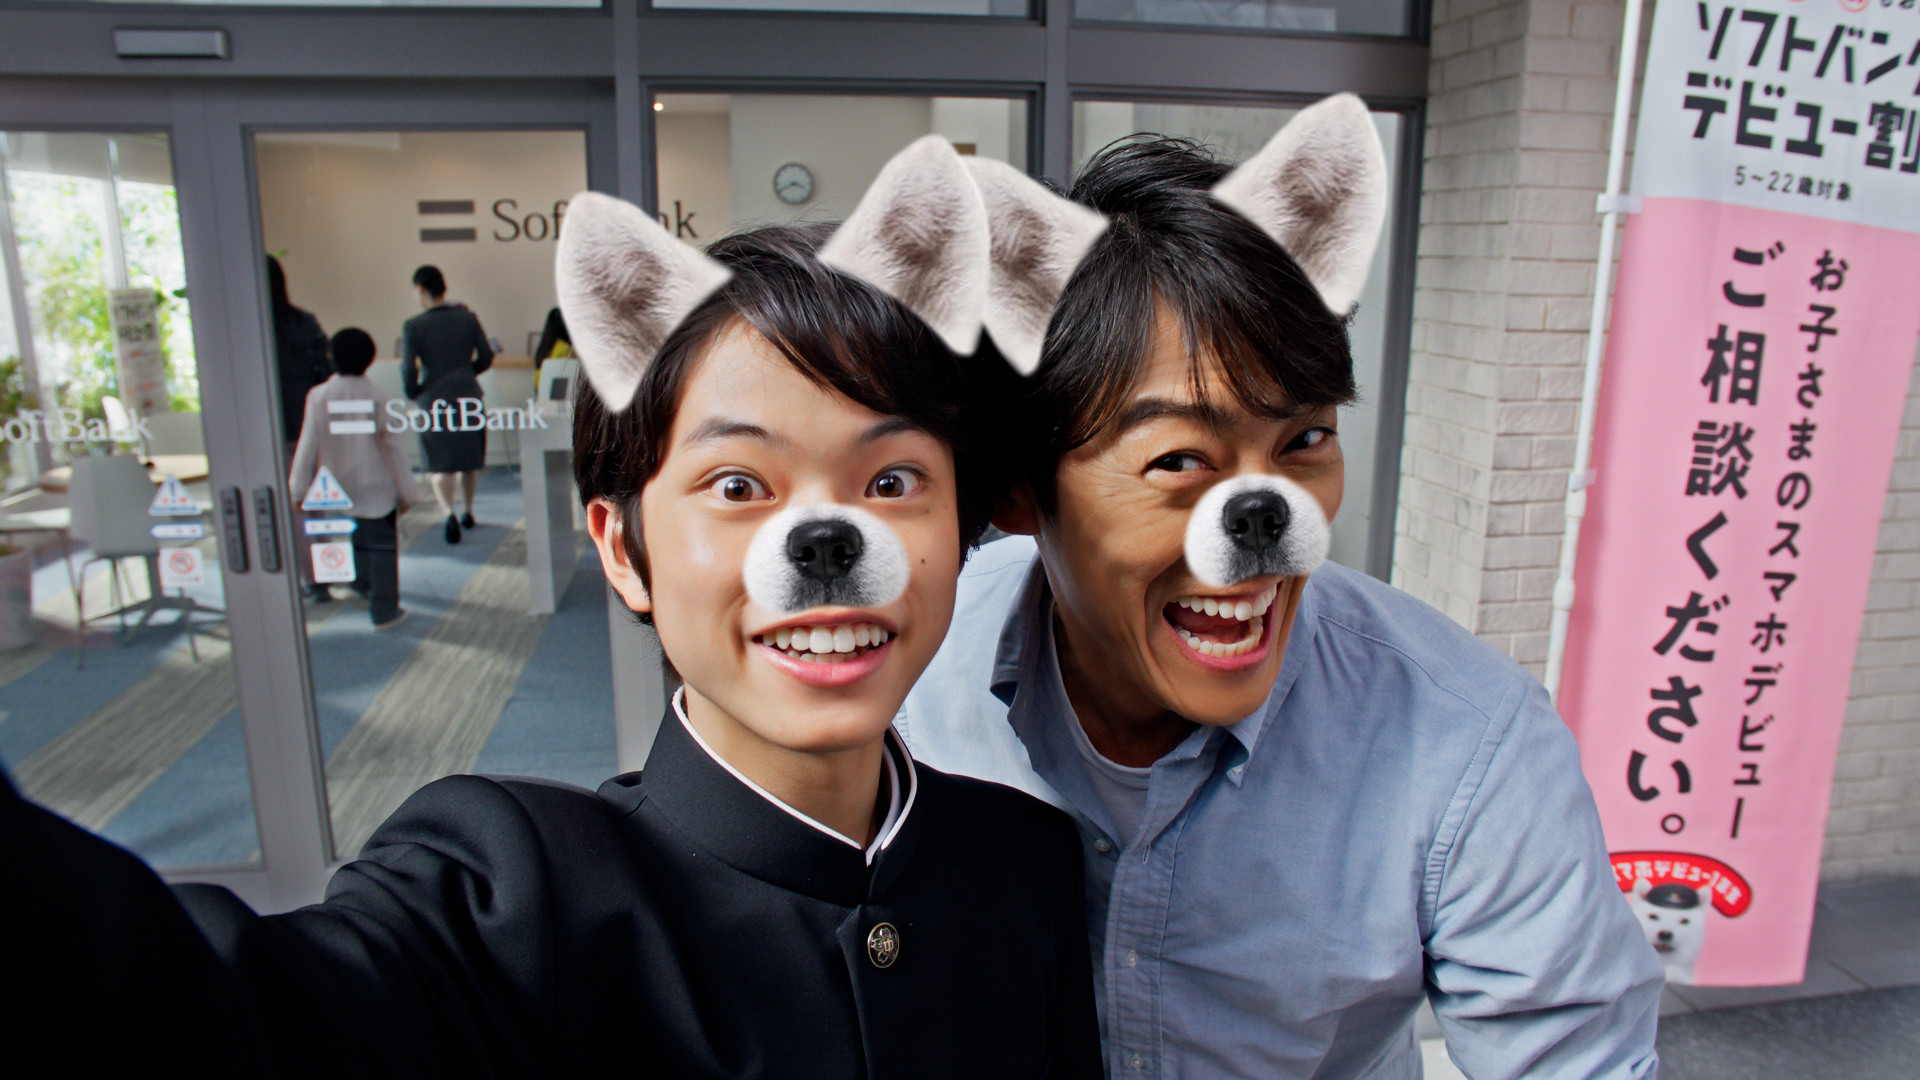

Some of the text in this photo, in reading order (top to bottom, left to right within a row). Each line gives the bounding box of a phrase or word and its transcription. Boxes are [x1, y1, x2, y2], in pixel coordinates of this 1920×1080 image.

[1683, 71, 1920, 173] デビュー割
[385, 397, 548, 433] SoftBank
[1627, 240, 1786, 835] ご相談ください。
[1730, 249, 1849, 839] お子さまのスマホデビュー
